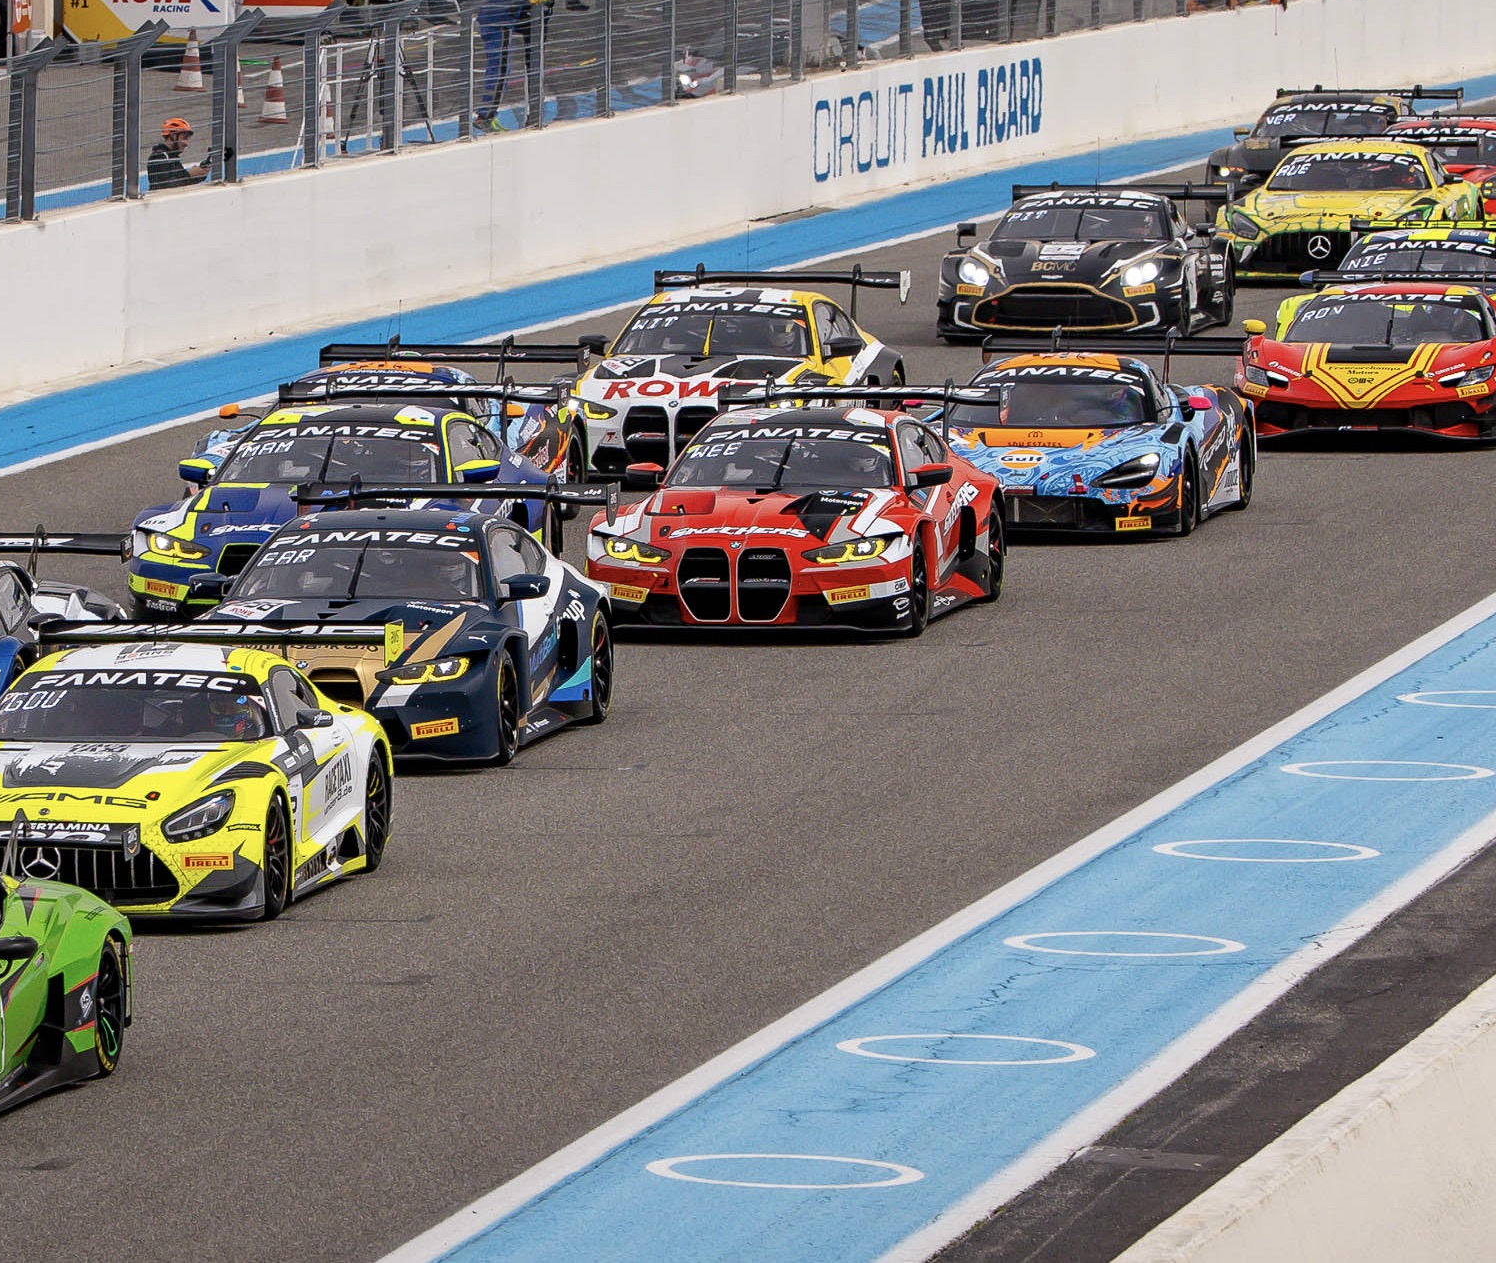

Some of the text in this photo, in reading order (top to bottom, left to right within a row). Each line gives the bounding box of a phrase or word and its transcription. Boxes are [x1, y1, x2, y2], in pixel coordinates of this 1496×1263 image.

[152, 5, 190, 13] RACING
[1272, 102, 1388, 113] FANATEC
[813, 57, 1042, 183] CIRCUIT PAUL RICARD
[1291, 151, 1417, 165] FANATEC
[1019, 196, 1158, 210] FANATEC
[1007, 209, 1048, 223] PIT
[1347, 252, 1388, 270] NIE
[1322, 293, 1464, 304] FANATEC
[639, 302, 803, 318] FANATEC
[1300, 305, 1345, 322] ROV
[630, 315, 679, 331] WIT
[975, 365, 1143, 384] FANATEC
[602, 381, 721, 400] ROW
[252, 424, 432, 442] FANATEC
[704, 427, 886, 444] FANATEC
[690, 441, 744, 459] WEE
[1000, 454, 1046, 465] Gulf
[820, 496, 864, 507] Motorsport
[667, 524, 810, 539] SKECHERS
[1118, 518, 1149, 529] PIRELLI
[269, 531, 475, 549] FANATEC
[256, 548, 316, 567] FAR
[830, 586, 869, 602] PIRELLI
[406, 602, 454, 615] Motorsport
[31, 673, 246, 691] FANATEC
[415, 721, 457, 738] PIRELLI
[2, 791, 150, 809] AMG
[185, 855, 230, 869] PIRELLI
